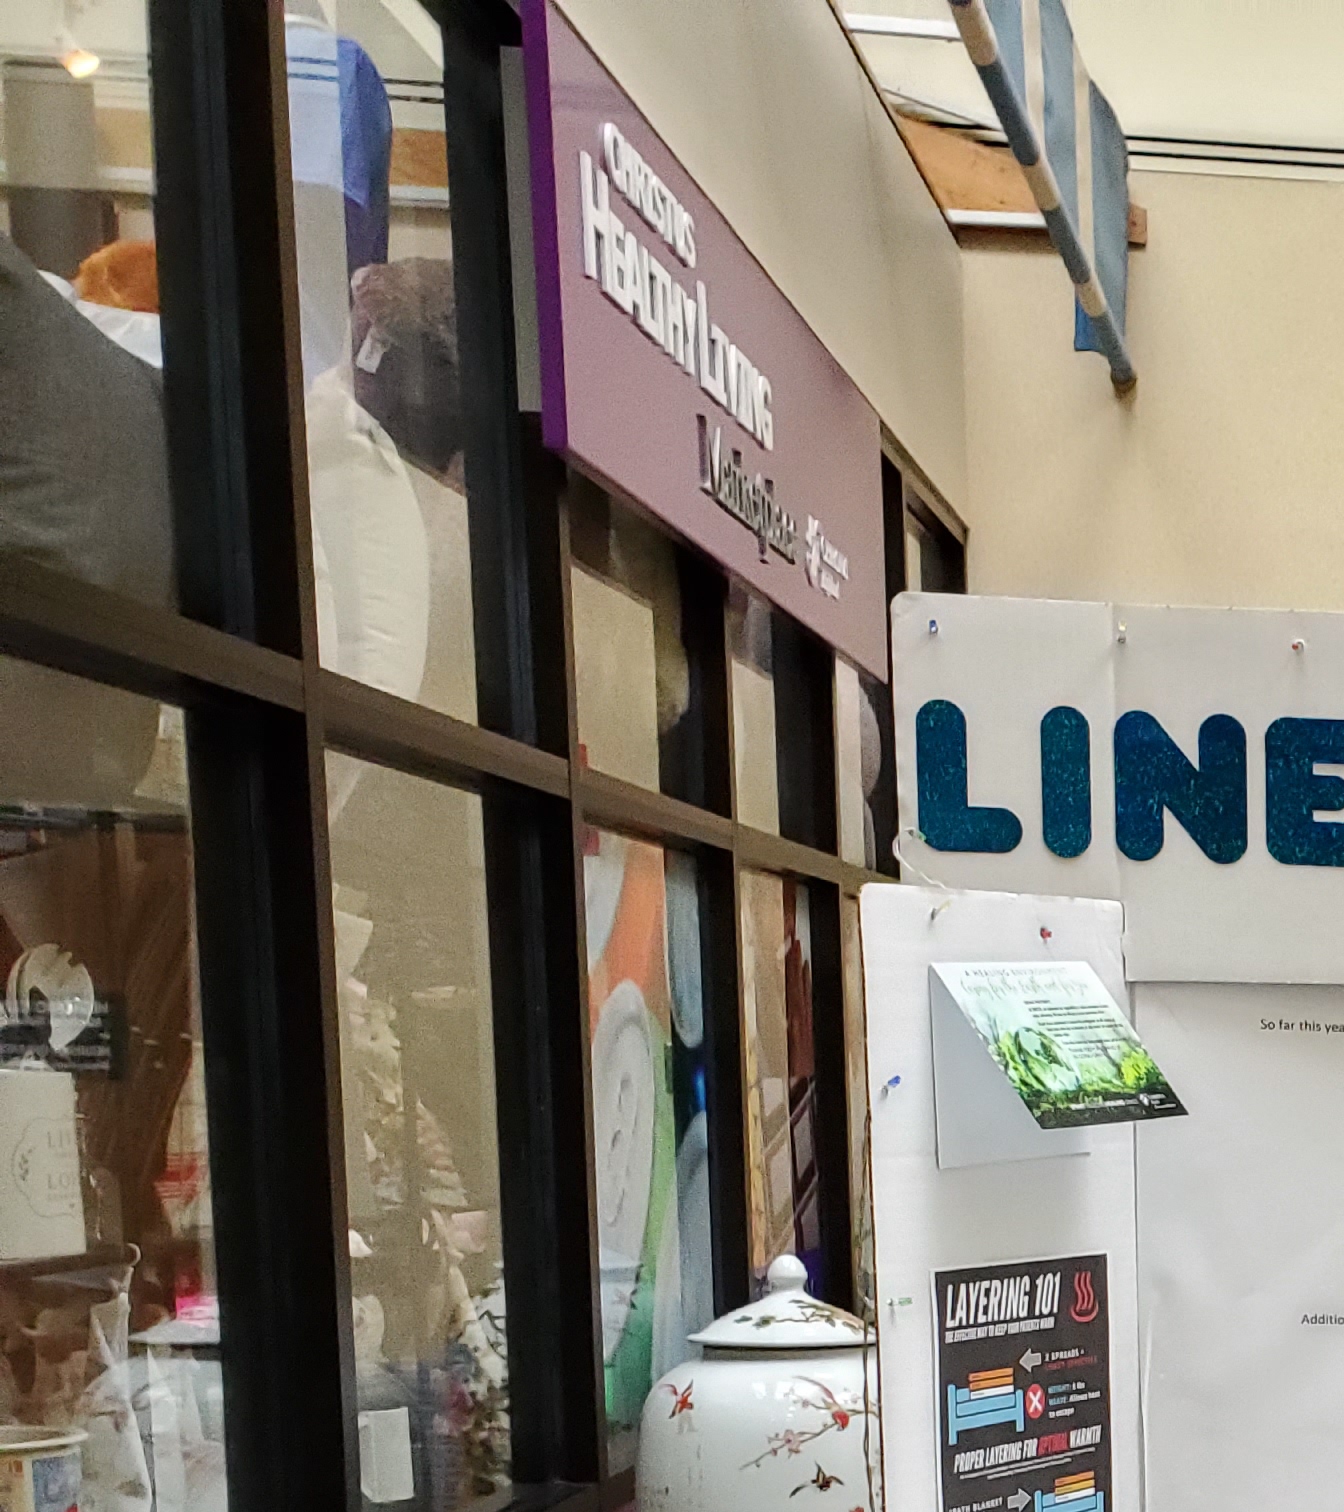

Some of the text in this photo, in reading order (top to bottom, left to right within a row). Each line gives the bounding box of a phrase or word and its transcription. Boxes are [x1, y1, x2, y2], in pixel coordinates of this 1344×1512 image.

[603, 122, 695, 268] CHRISTUS
[1260, 1019, 1275, 1030] So
[1279, 1020, 1295, 1031] far
[1299, 1020, 1321, 1032] this
[945, 1271, 1061, 1329] LAYERING 101
[953, 1448, 985, 1475] PROPER
[985, 1441, 1022, 1469] LAYERING
[1022, 1437, 1038, 1459] FOR
[1069, 1424, 1102, 1450] WARMTH
